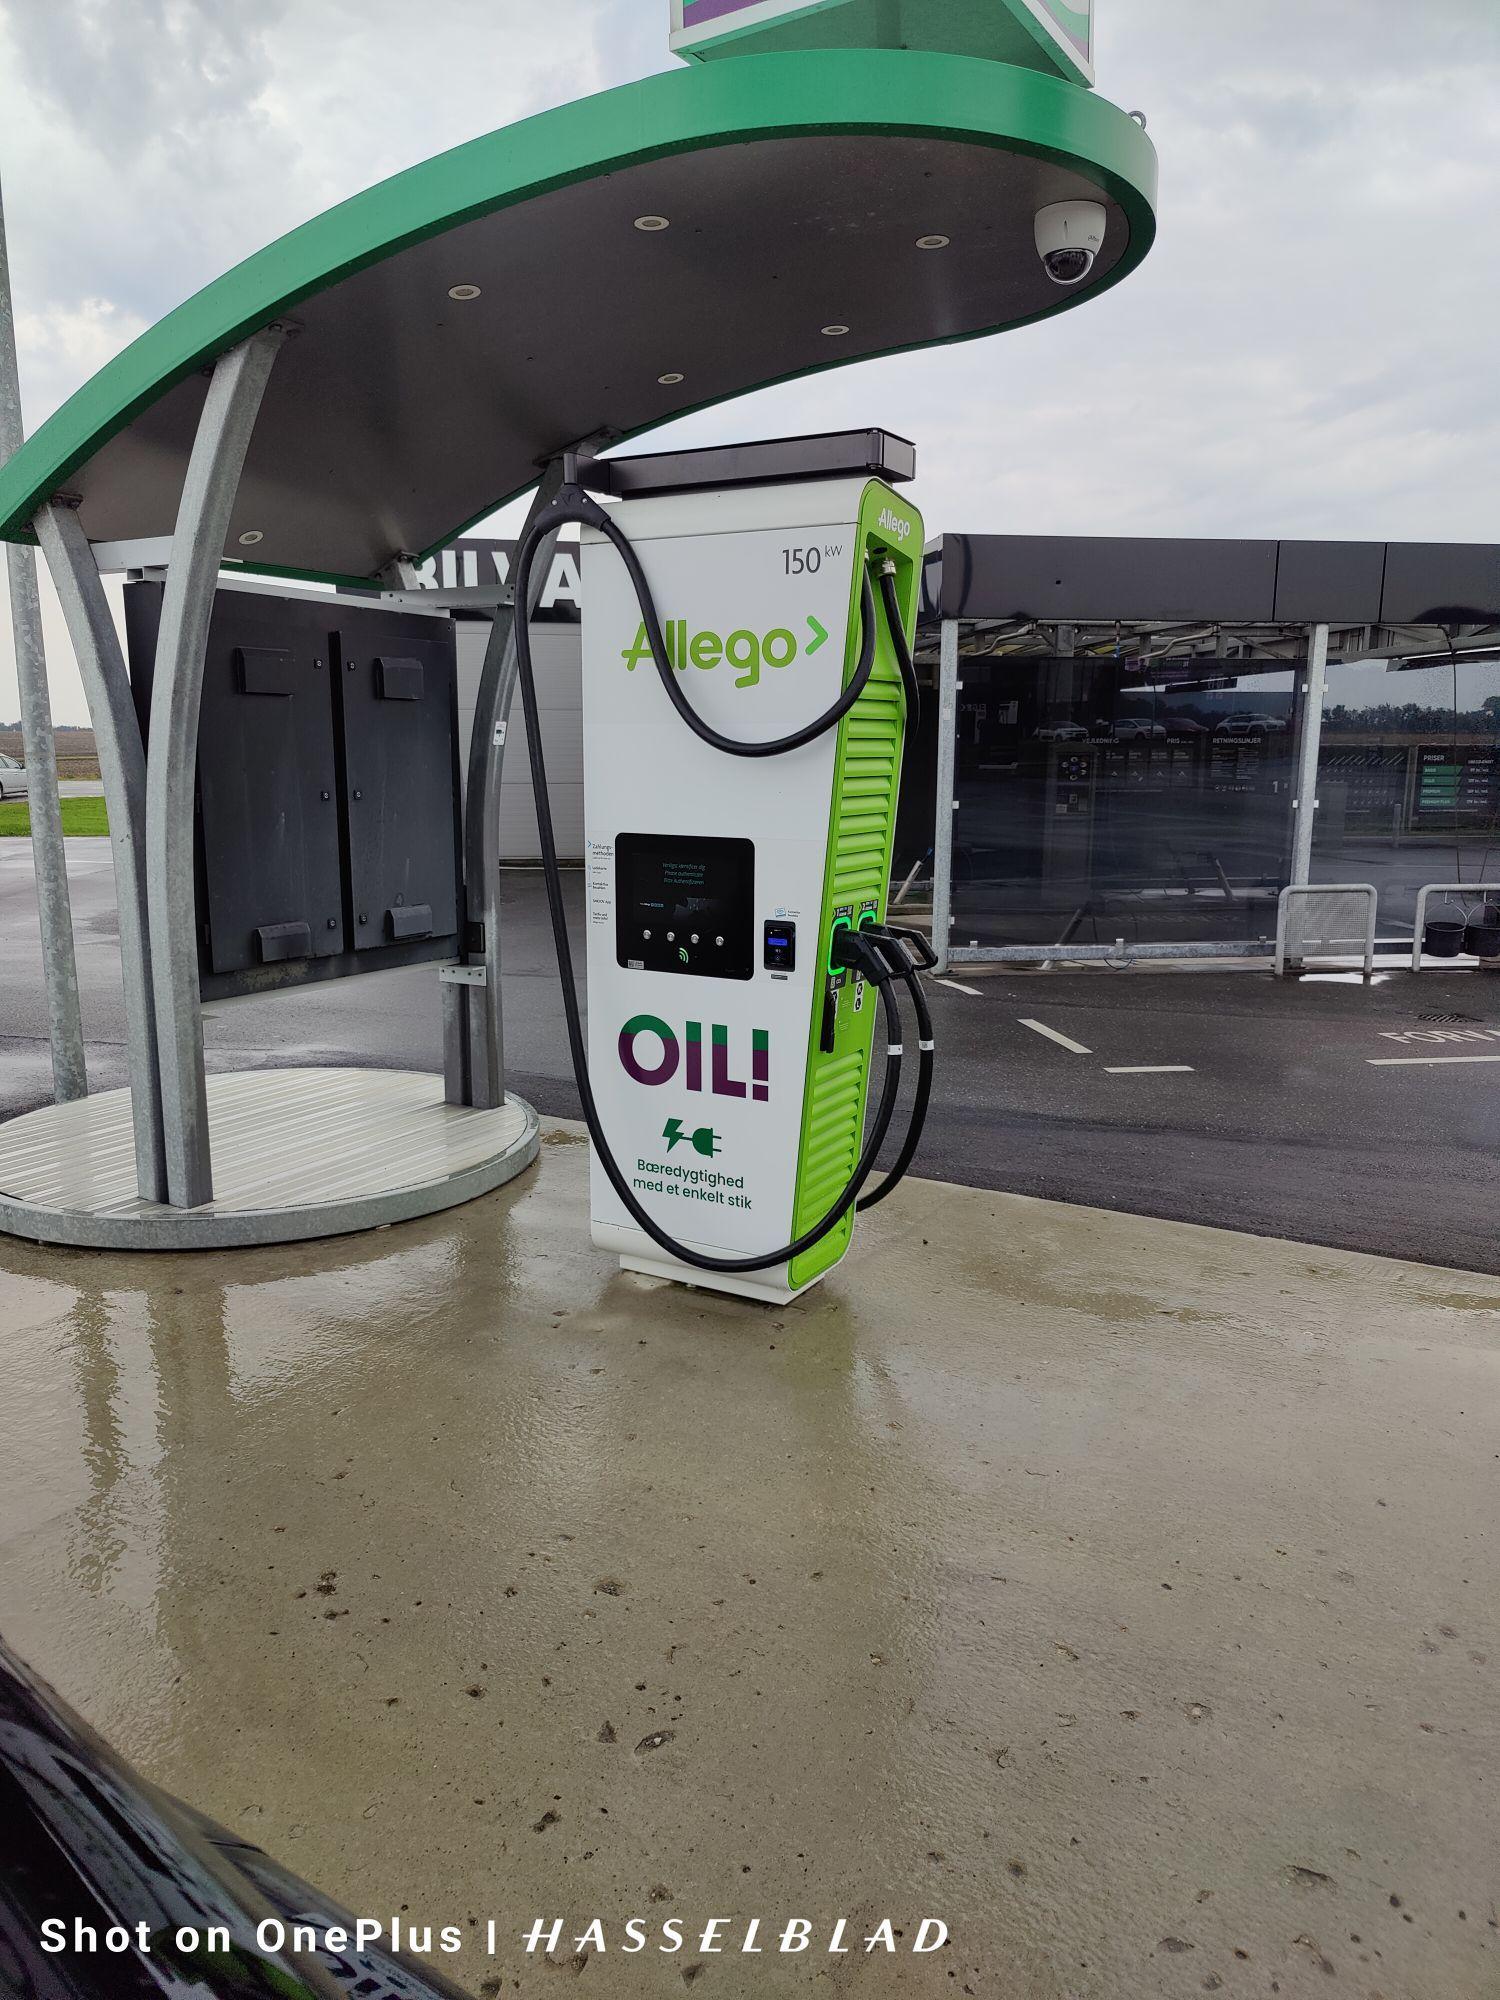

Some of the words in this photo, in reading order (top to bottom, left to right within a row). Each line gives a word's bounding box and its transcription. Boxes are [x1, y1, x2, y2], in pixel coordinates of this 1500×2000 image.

[878, 507, 910, 541] Allego
[782, 546, 821, 575] 150
[824, 545, 843, 558] kW
[618, 1014, 769, 1102] OIL!
[637, 1158, 744, 1189] Bæredygtighed
[633, 1177, 663, 1193] med
[666, 1182, 680, 1196] et
[683, 1184, 724, 1205] enkelt
[728, 1193, 752, 1210] stik
